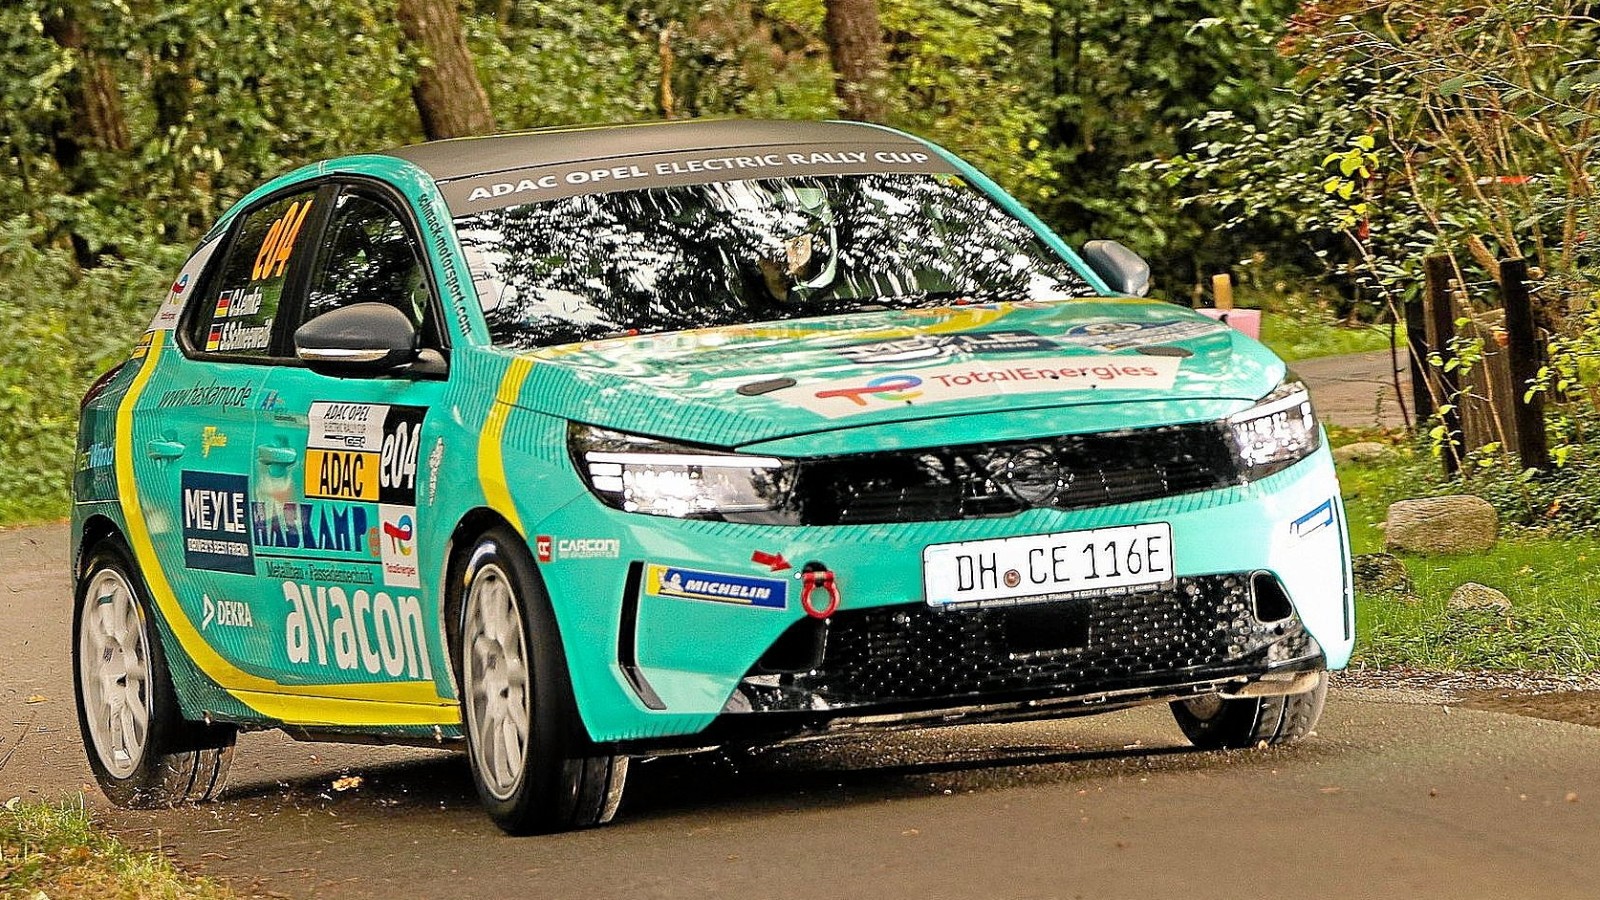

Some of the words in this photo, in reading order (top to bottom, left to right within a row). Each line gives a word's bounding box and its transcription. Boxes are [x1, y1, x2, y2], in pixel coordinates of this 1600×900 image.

[468, 175, 558, 201] ADAC
[565, 166, 649, 185] OPEL
[655, 154, 783, 175] ELECTRIC
[789, 151, 867, 166] RALLY
[875, 151, 929, 164] CUP
[252, 199, 313, 280] e04
[931, 363, 1158, 387] TotalEnergies
[323, 404, 349, 420] ADAC
[348, 405, 370, 422] OPEL
[320, 452, 364, 497] ADAC
[380, 421, 422, 489] e04
[184, 488, 247, 534] MEYLE
[252, 501, 368, 552] HASKAMP
[956, 552, 998, 592] DH
[1028, 545, 1071, 585] CE
[1082, 535, 1165, 580] 116E
[685, 579, 771, 599] MICHELIN
[216, 600, 253, 628] DEKRA
[282, 580, 433, 680] avacon
